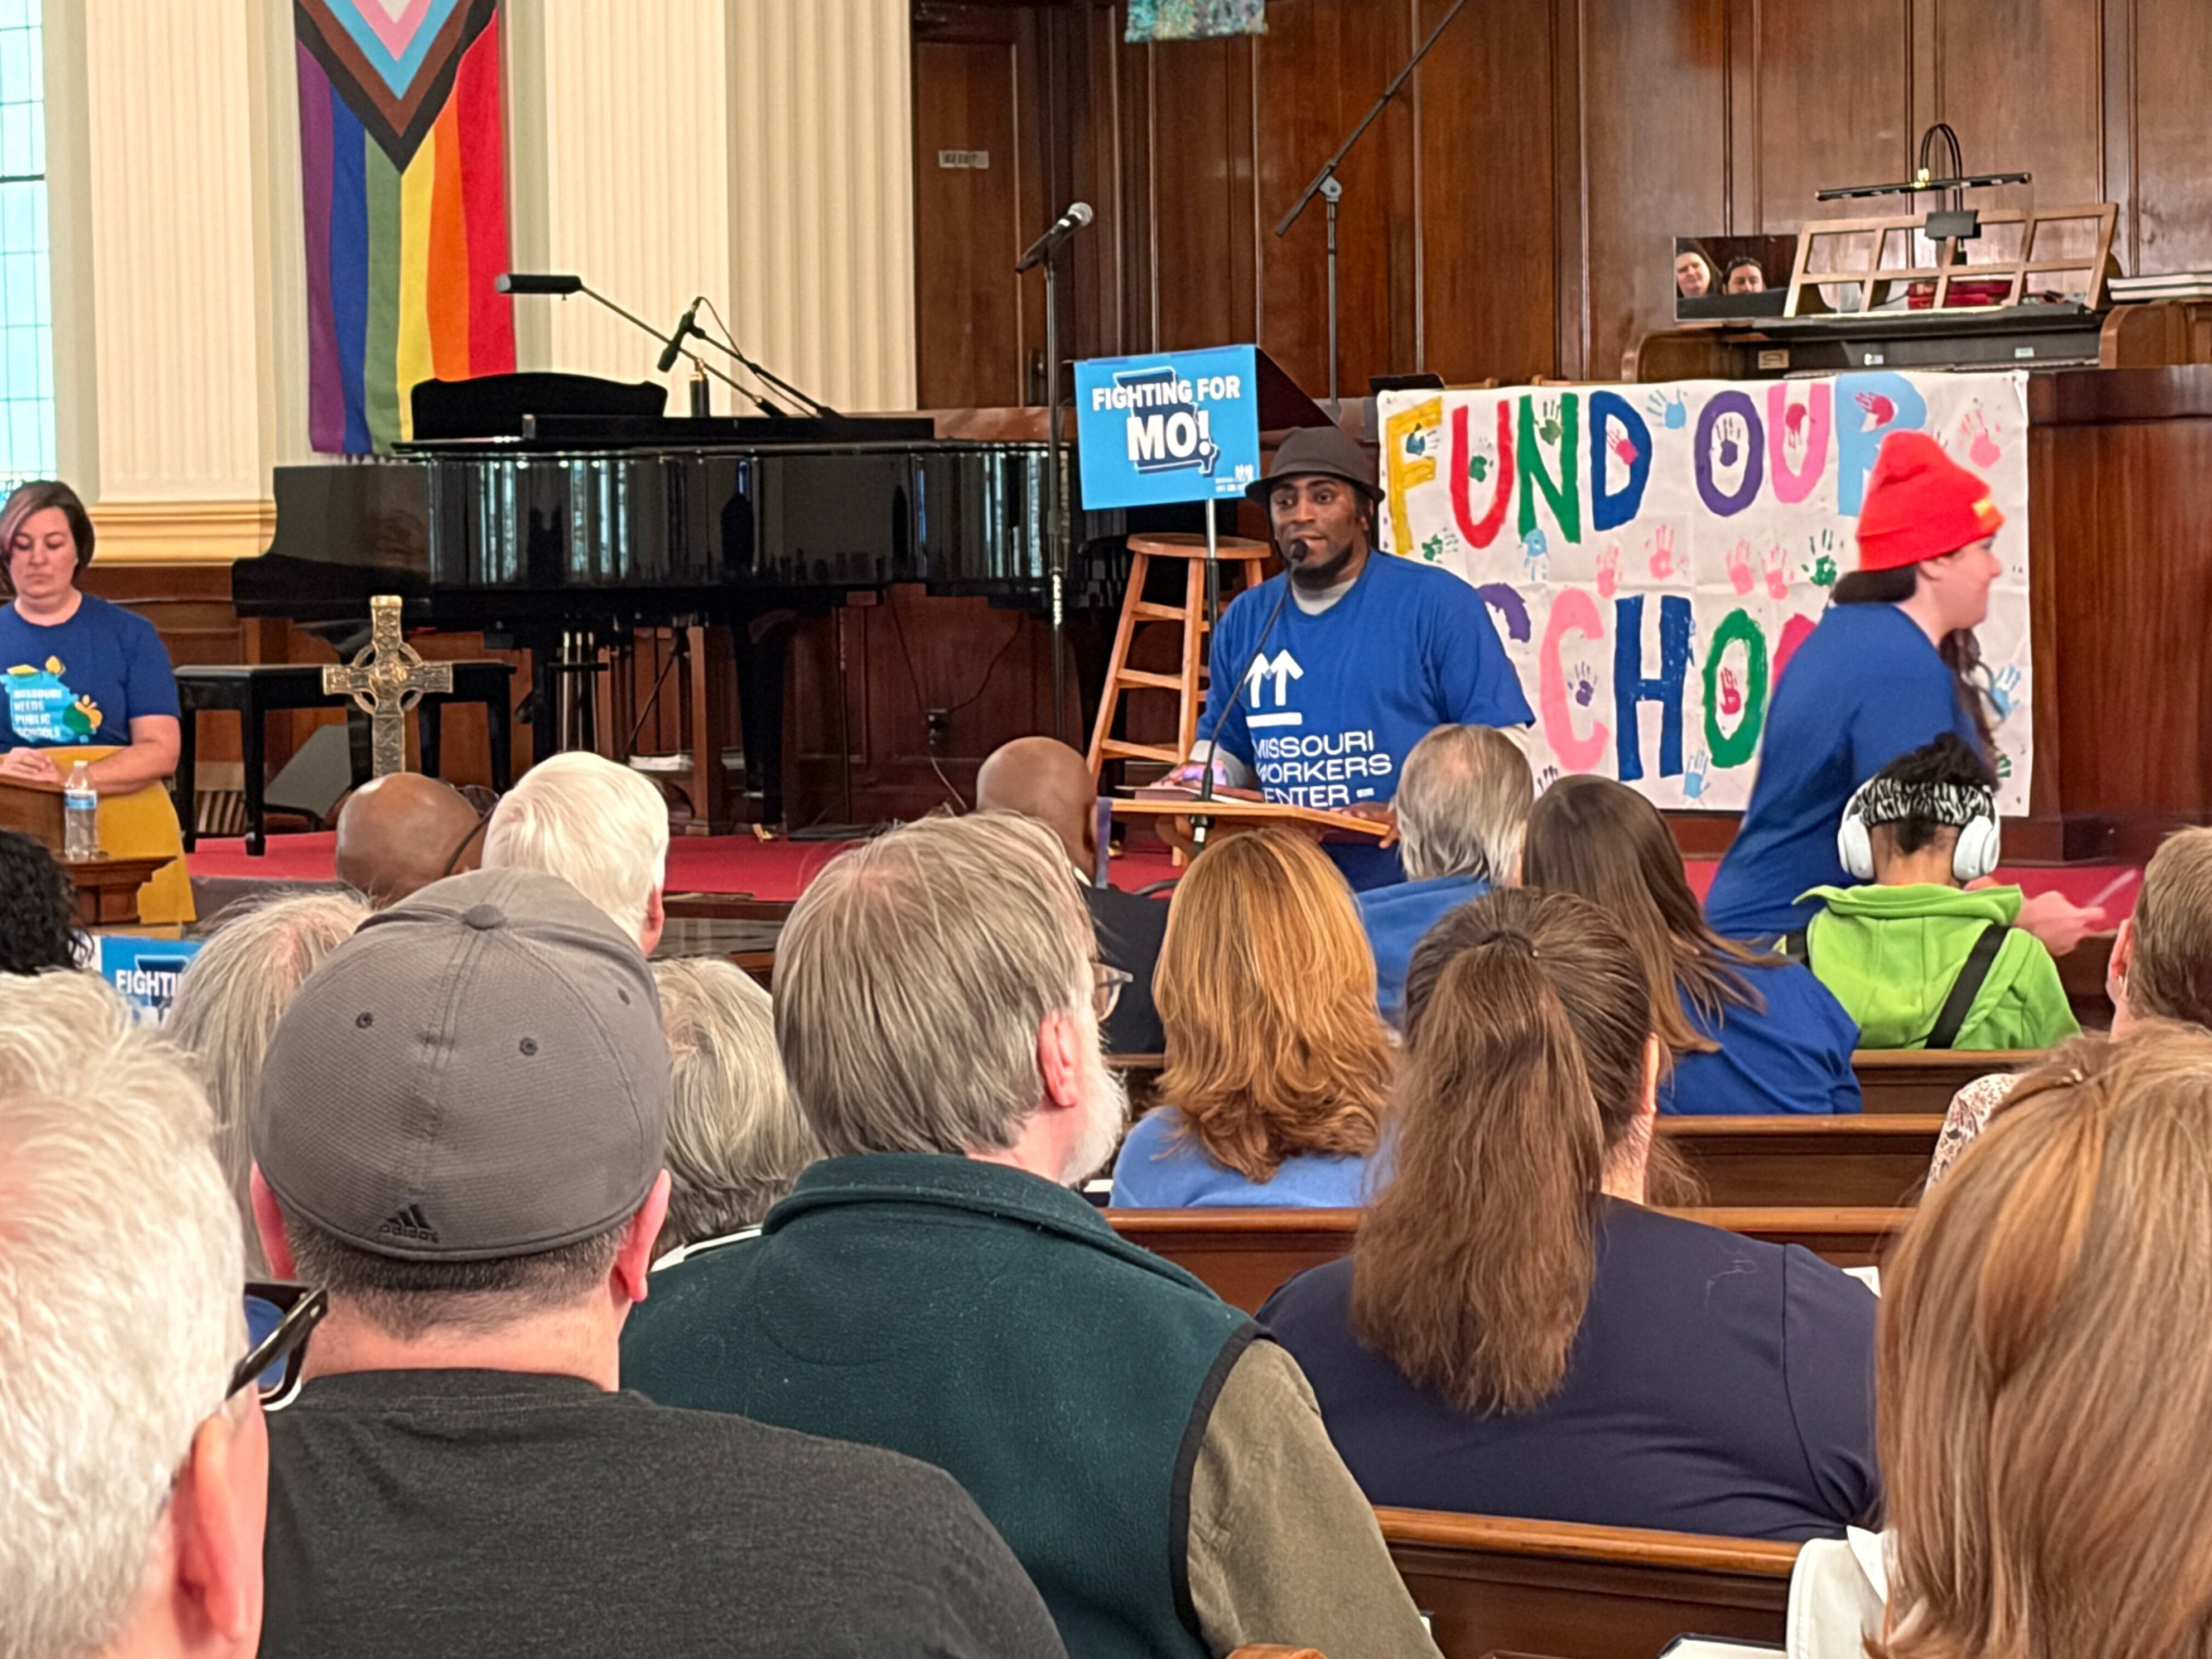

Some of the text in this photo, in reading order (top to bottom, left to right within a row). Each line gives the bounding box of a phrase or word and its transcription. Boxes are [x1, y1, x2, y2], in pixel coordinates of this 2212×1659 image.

[1091, 375, 1241, 411] FIGHTING FOR
[1126, 410, 1211, 462] MO!
[1385, 371, 1928, 556] FUND OUR
[1252, 730, 1374, 759] MISSOURI
[1256, 753, 1392, 784] WORKERS
[1262, 784, 1351, 808] ENTER
[115, 969, 180, 999] FIGHTI
